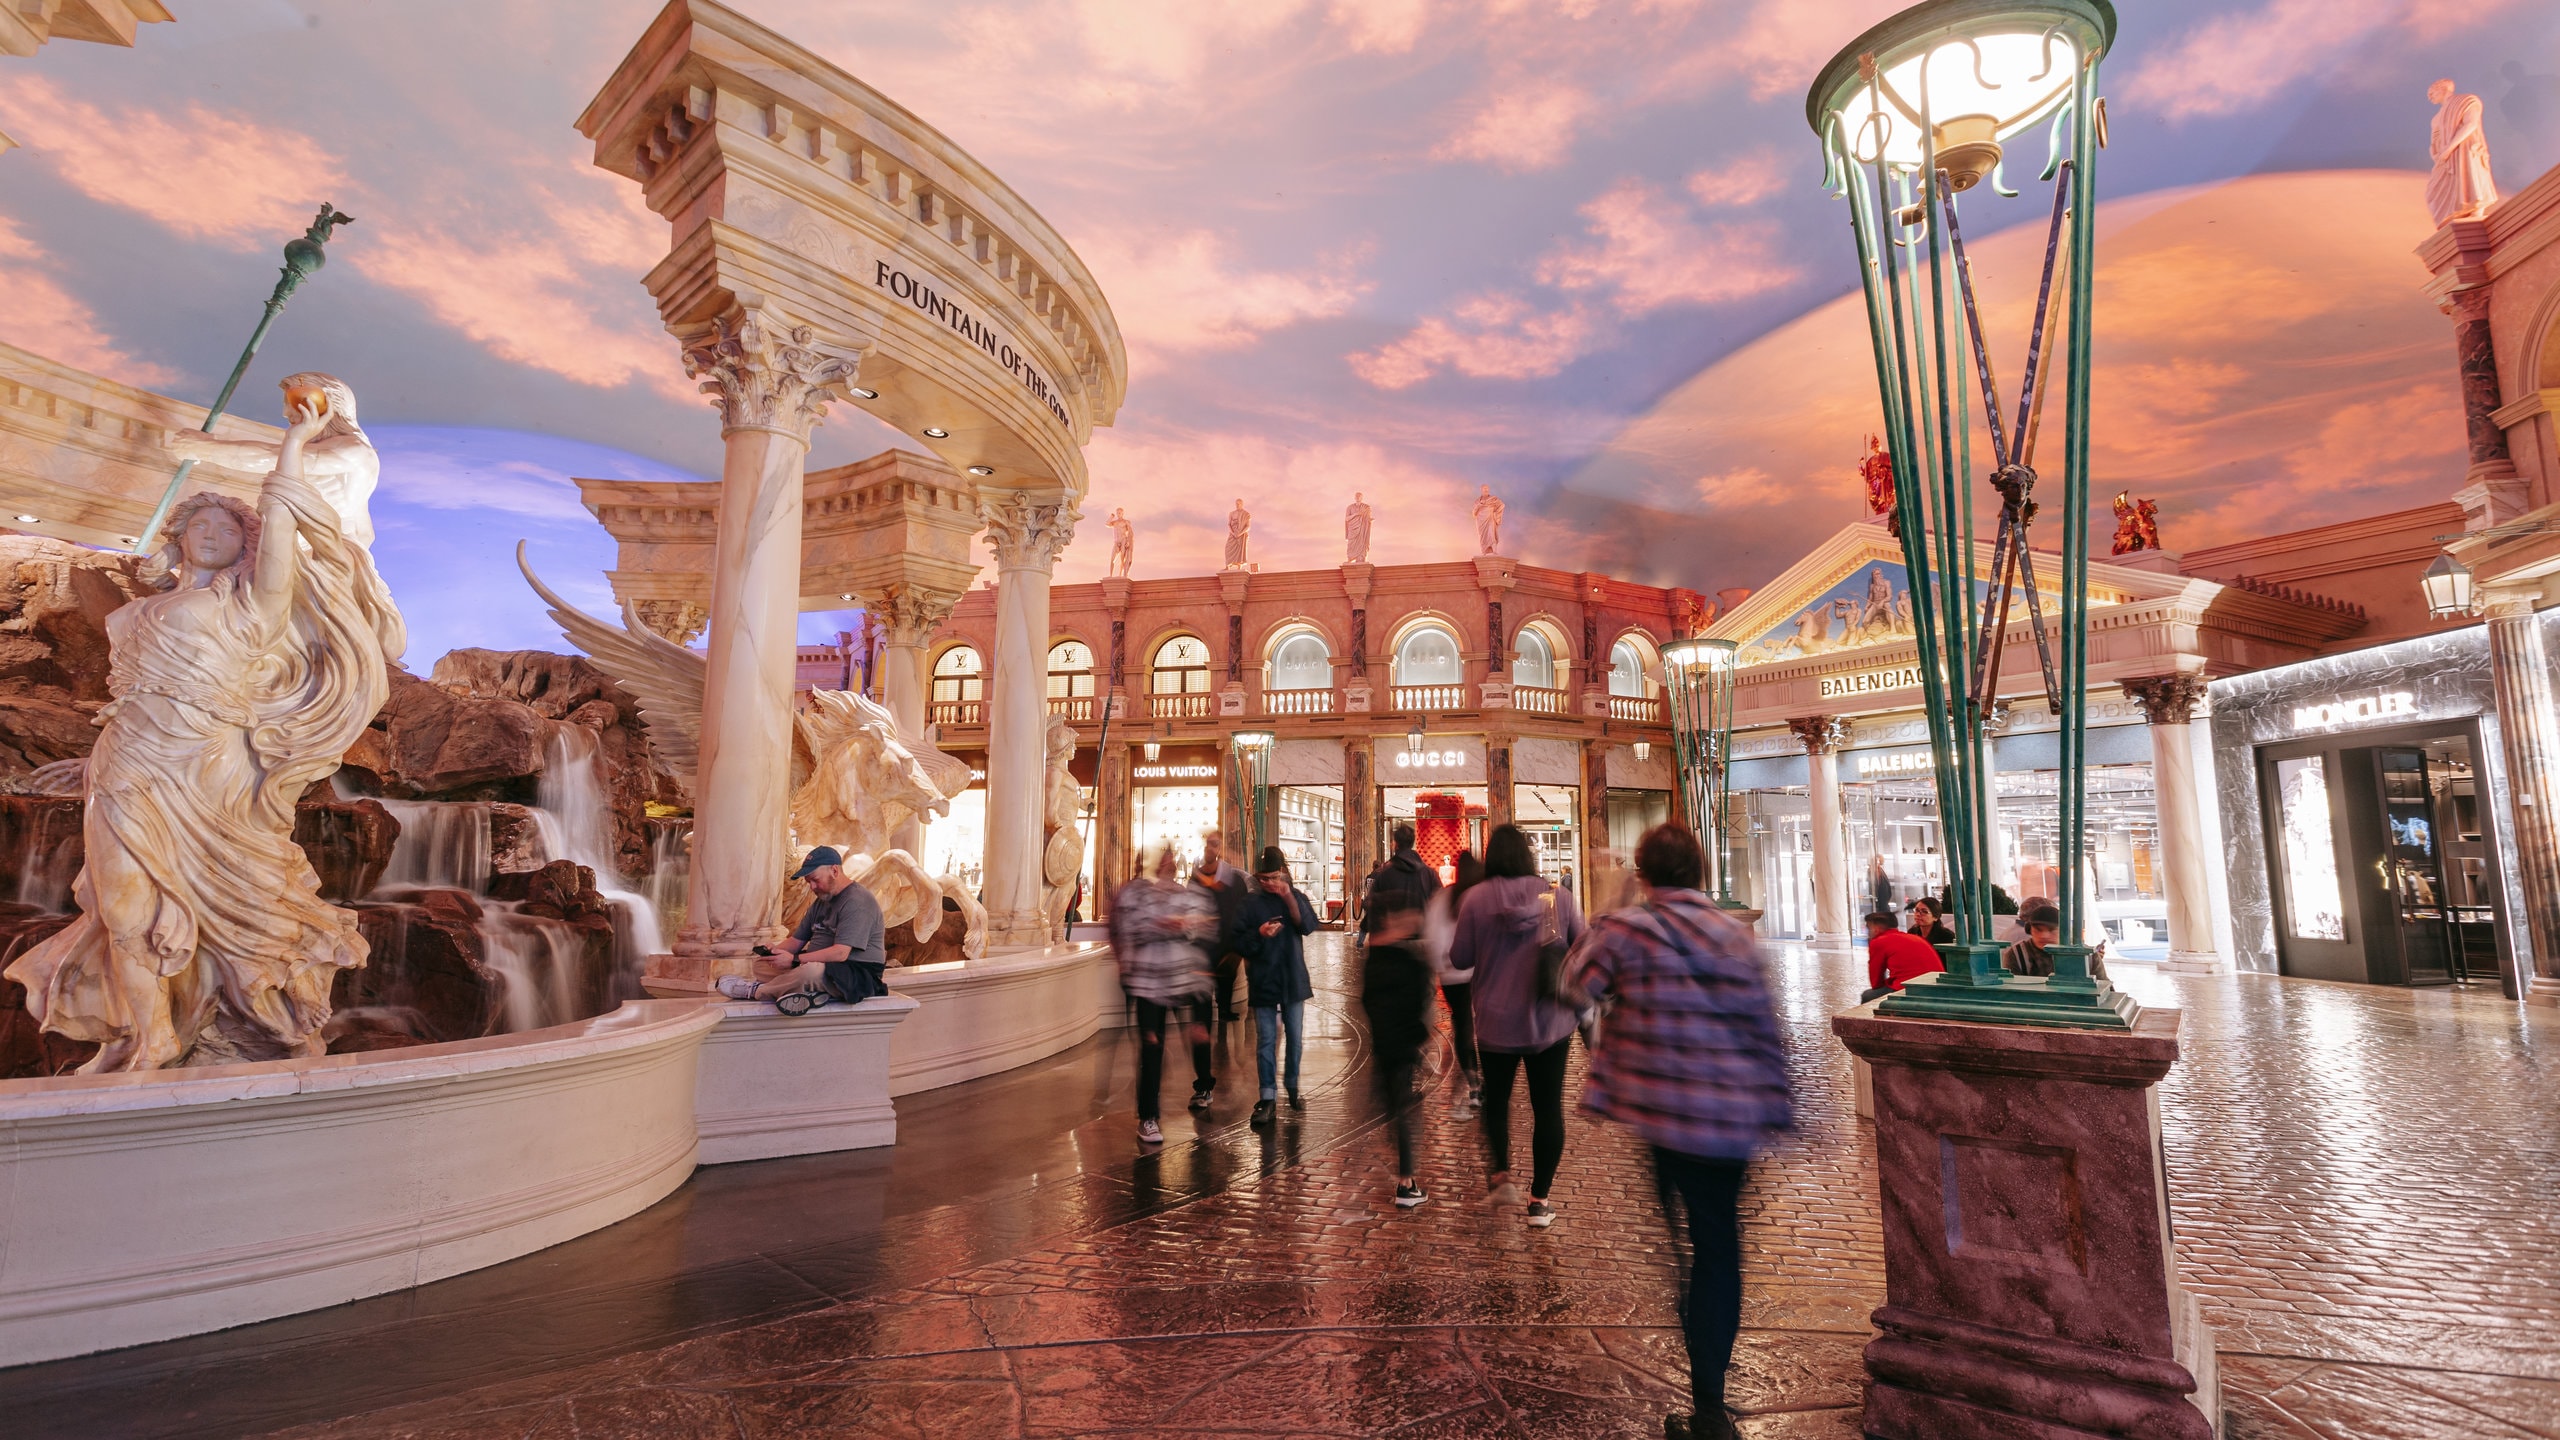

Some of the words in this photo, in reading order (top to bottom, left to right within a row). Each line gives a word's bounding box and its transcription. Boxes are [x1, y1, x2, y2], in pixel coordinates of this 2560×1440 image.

[875, 260, 997, 357] FOUNTAIN
[1001, 345, 1022, 376] OF
[1023, 362, 1048, 404] THE
[2294, 692, 2418, 729] MONCLER
[1396, 751, 1465, 767] GUCCI
[1858, 751, 1958, 773] BALENCI
[1134, 767, 1167, 778] LOUIS
[1168, 765, 1217, 777] VUITTON
